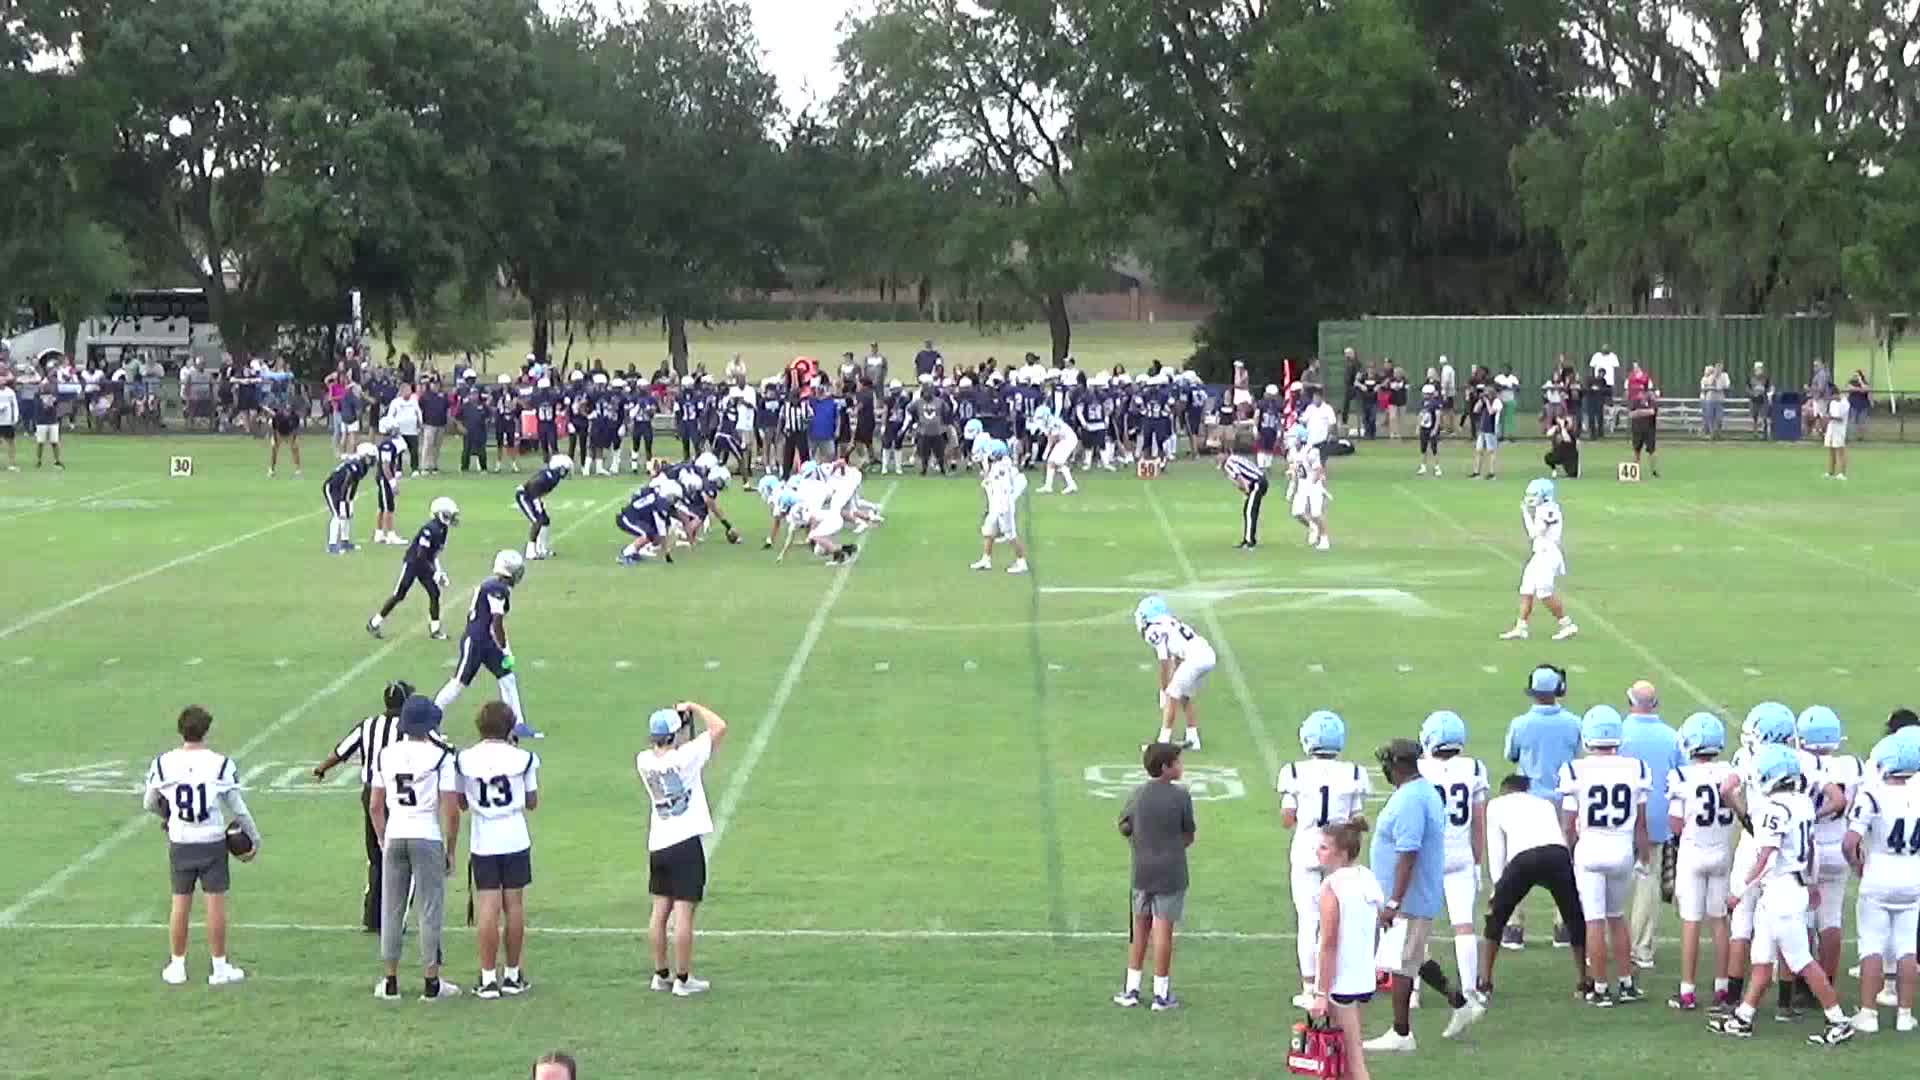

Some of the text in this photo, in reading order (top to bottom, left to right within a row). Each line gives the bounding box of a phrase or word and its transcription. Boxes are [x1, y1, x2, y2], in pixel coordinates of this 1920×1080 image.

[174, 458, 190, 473] 30
[1621, 463, 1638, 478] 40
[395, 773, 417, 807] 5
[476, 774, 513, 808] 13
[1317, 785, 1330, 828] 1
[1588, 783, 1632, 828] 29
[1762, 814, 1779, 831] 15
